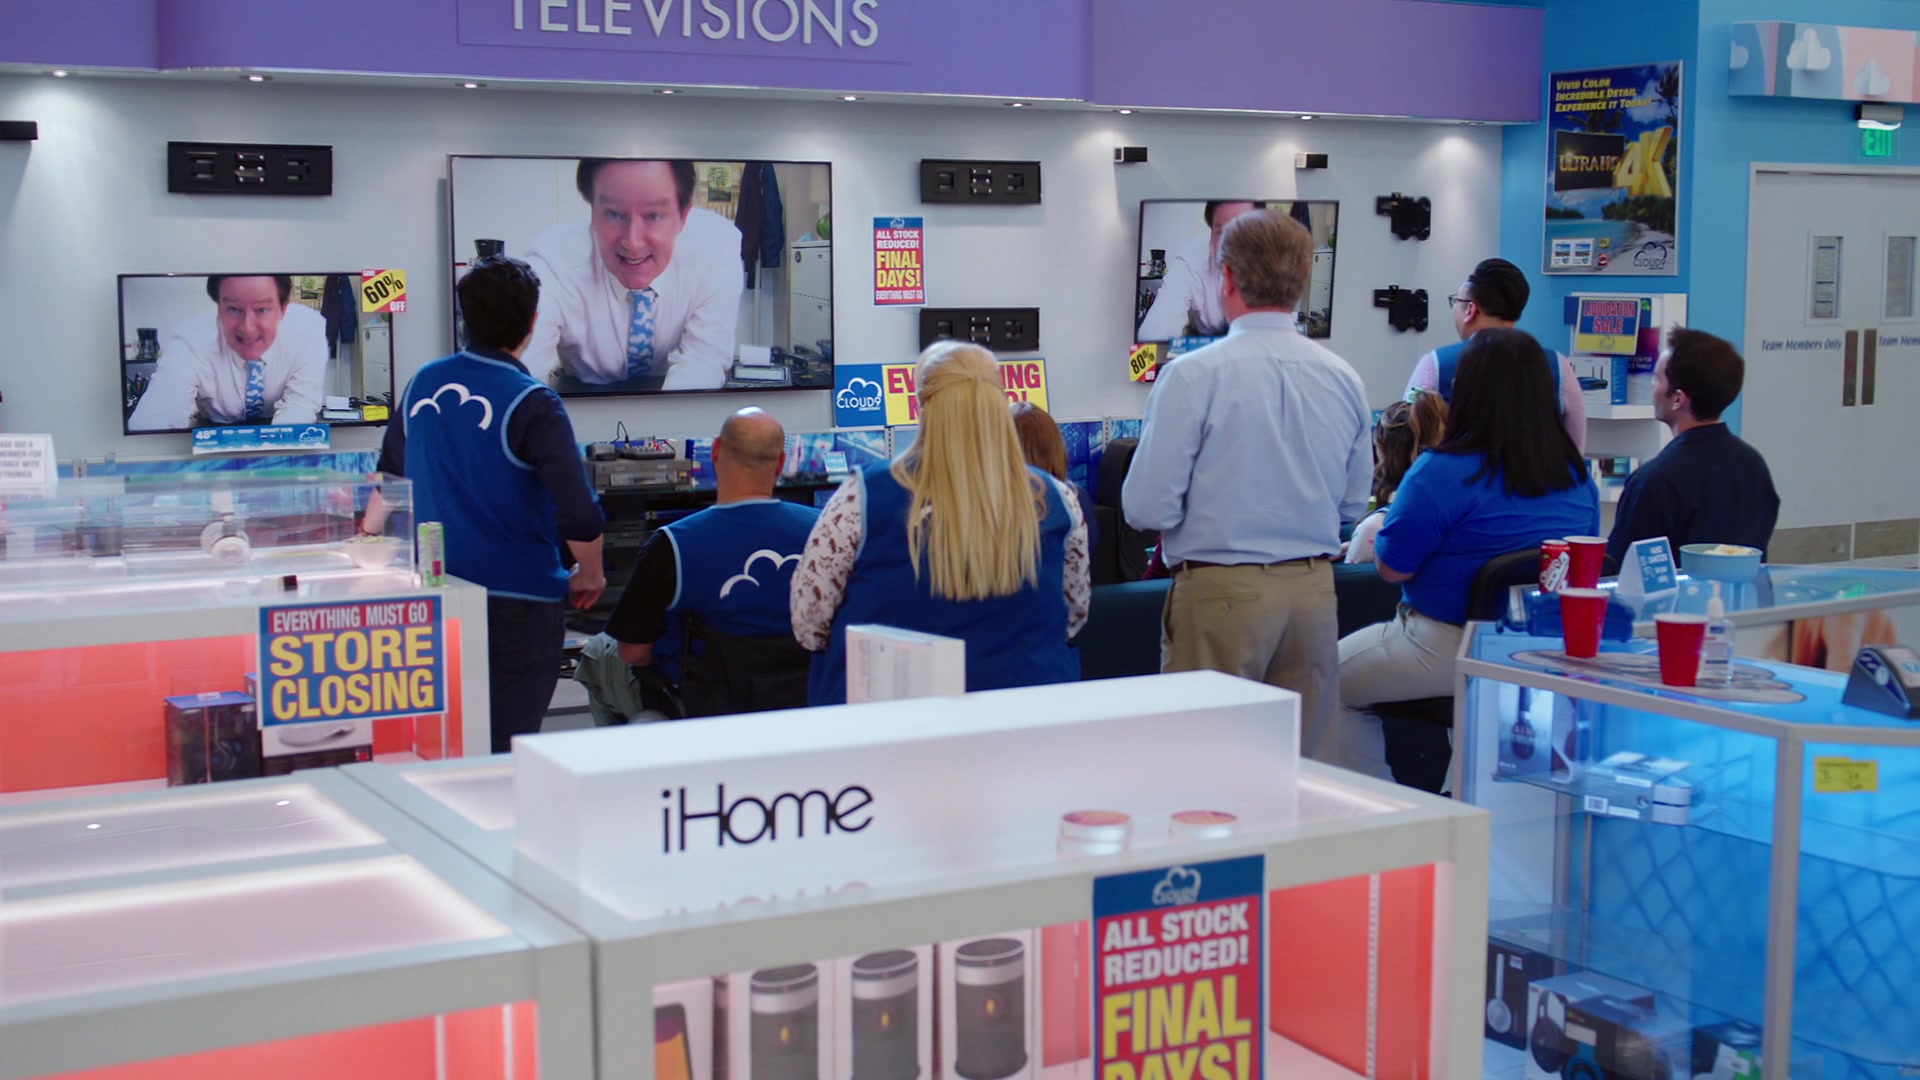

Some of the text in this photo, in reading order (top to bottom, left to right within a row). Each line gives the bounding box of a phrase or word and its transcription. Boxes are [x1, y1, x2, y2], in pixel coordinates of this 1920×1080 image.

[513, 0, 879, 48] TELEVISIONS
[1557, 79, 1611, 90] VIVID COLOR
[1556, 88, 1637, 101] INCREDIBLE DETAIL
[1555, 102, 1607, 112] EXPERIENCE
[1865, 128, 1892, 156] EXIT
[1613, 126, 1672, 197] 4K
[876, 230, 919, 239] ALL STOCK
[876, 240, 919, 249] REDUCED!
[876, 251, 920, 268] FINAL
[876, 269, 921, 287] DAYS!
[363, 272, 404, 304] 60%
[389, 301, 406, 312] OFF
[1583, 301, 1636, 317] LIQUIDATION
[1593, 317, 1625, 333] SALE
[1762, 338, 1842, 352] Team Members Only
[1879, 336, 1898, 346] Team
[1130, 346, 1155, 374] 80%
[1145, 371, 1155, 380] OFF
[836, 396, 881, 409] CLOUD9
[273, 602, 428, 634] EVERYTHING MUST GO
[270, 626, 434, 677] STORE
[272, 668, 435, 720] CLOSING
[661, 783, 874, 854] iHome
[1103, 902, 1249, 952] ALL STOCK
[1104, 935, 1249, 987] REDUCED!
[1103, 974, 1252, 1060] FINAL
[1103, 1039, 1252, 1080] YS!
